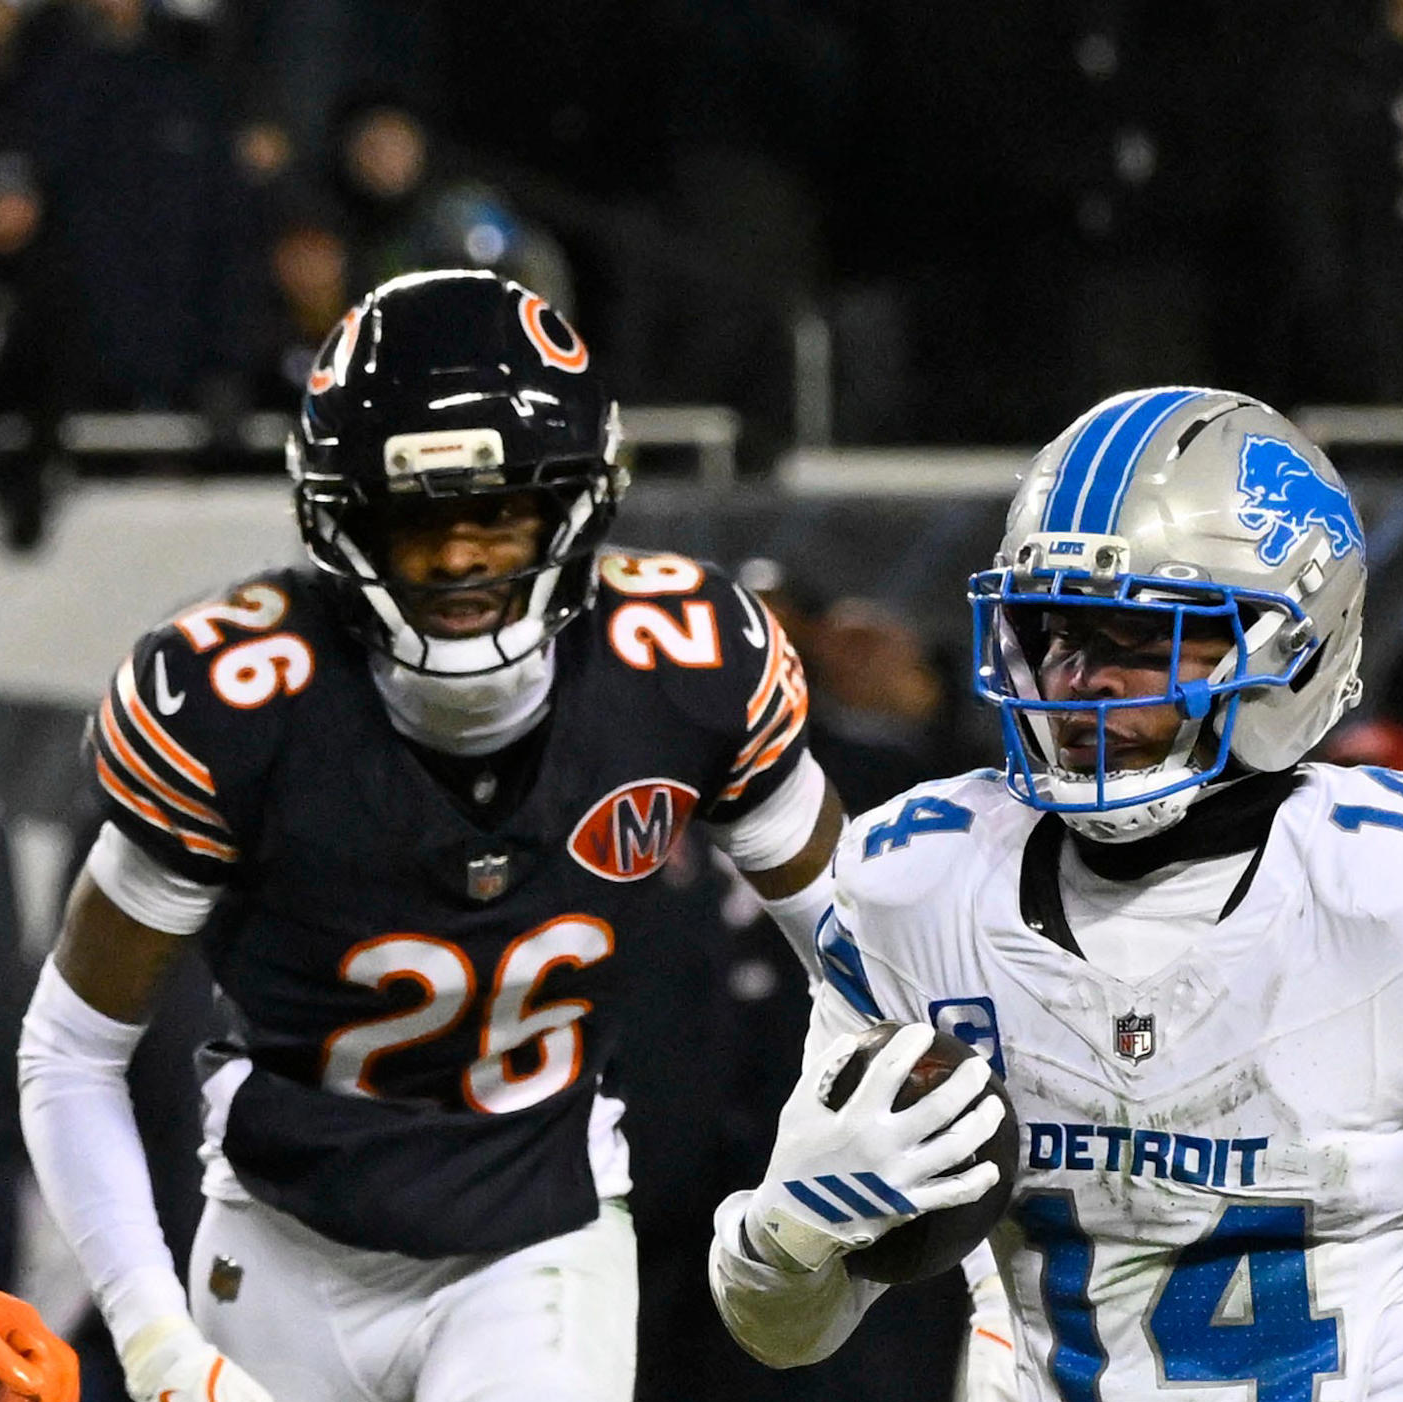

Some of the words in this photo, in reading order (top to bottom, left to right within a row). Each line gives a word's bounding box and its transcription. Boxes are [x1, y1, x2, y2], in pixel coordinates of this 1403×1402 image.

[172, 583, 315, 710] 26
[598, 553, 723, 671] 26
[321, 912, 615, 1115] 26
[1118, 1034, 1150, 1055] NFL
[1026, 1122, 1270, 1187] DETROIT
